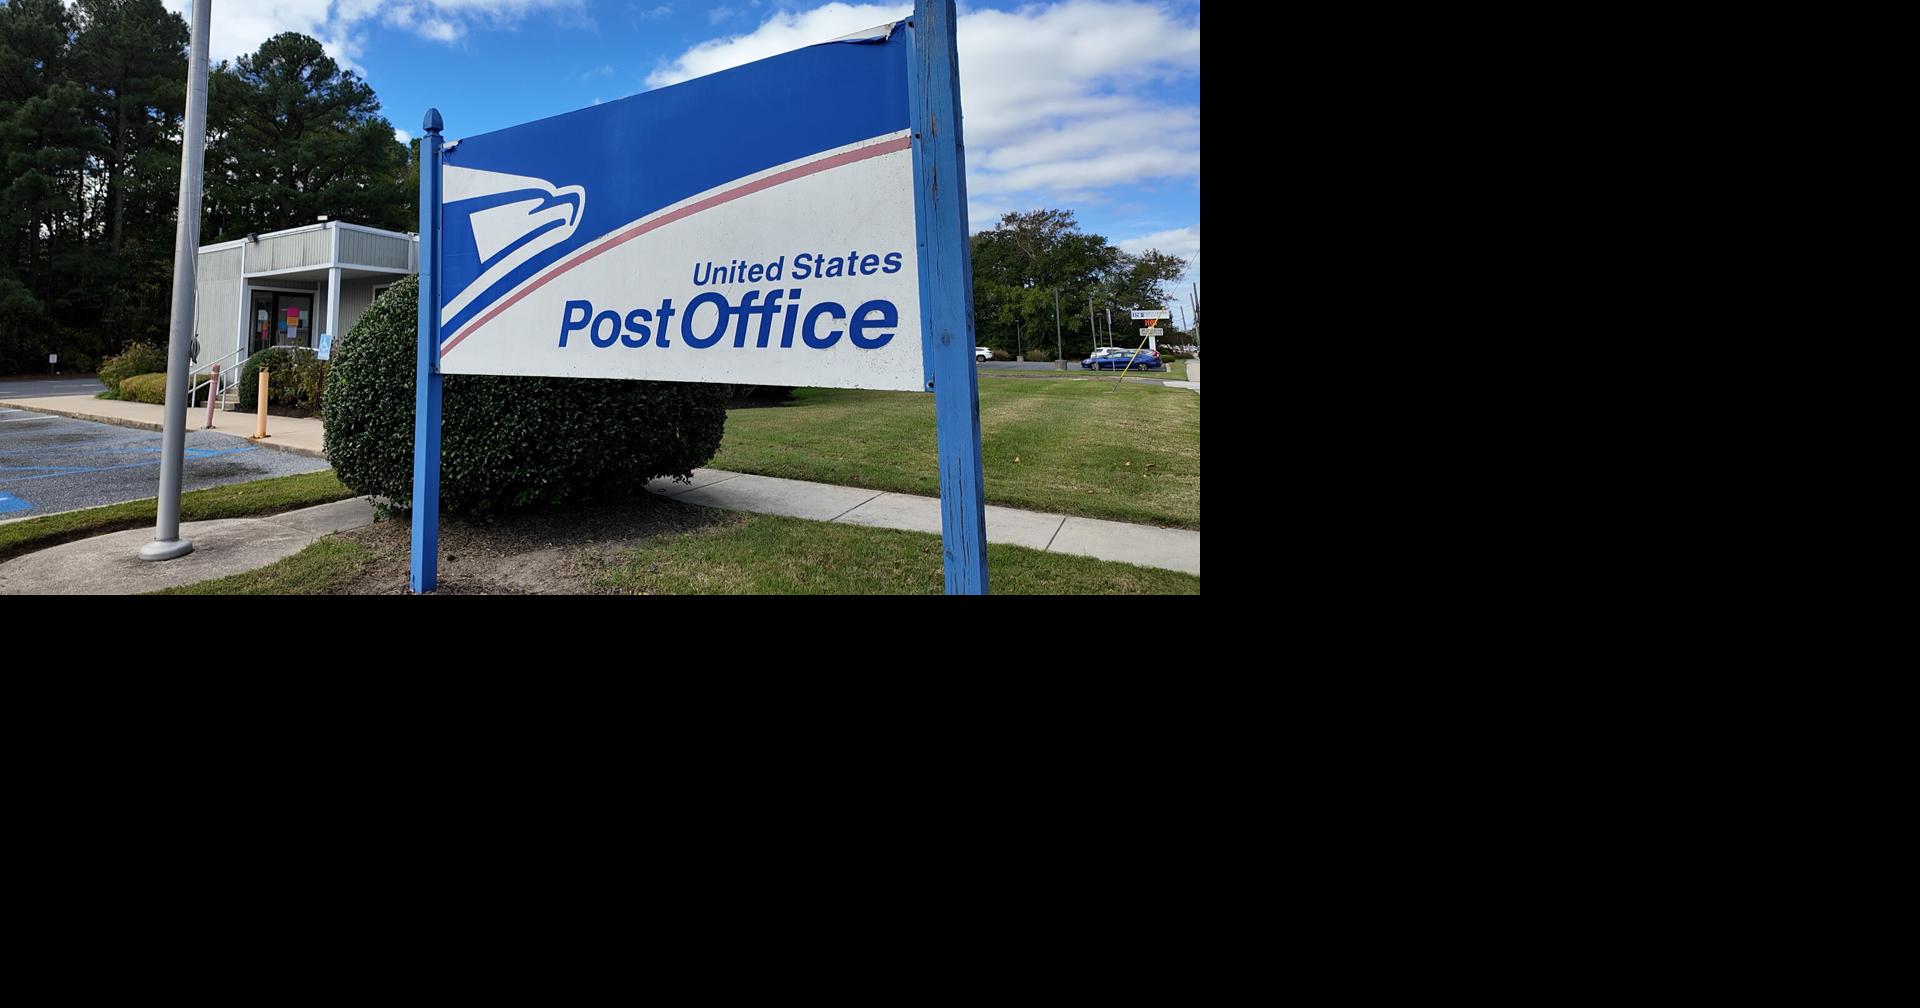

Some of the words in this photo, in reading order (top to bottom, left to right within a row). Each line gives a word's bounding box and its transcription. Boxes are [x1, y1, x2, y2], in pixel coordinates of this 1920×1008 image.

[693, 256, 785, 286] United
[791, 251, 903, 280] States
[558, 299, 676, 349] Post
[681, 288, 899, 350] Office
